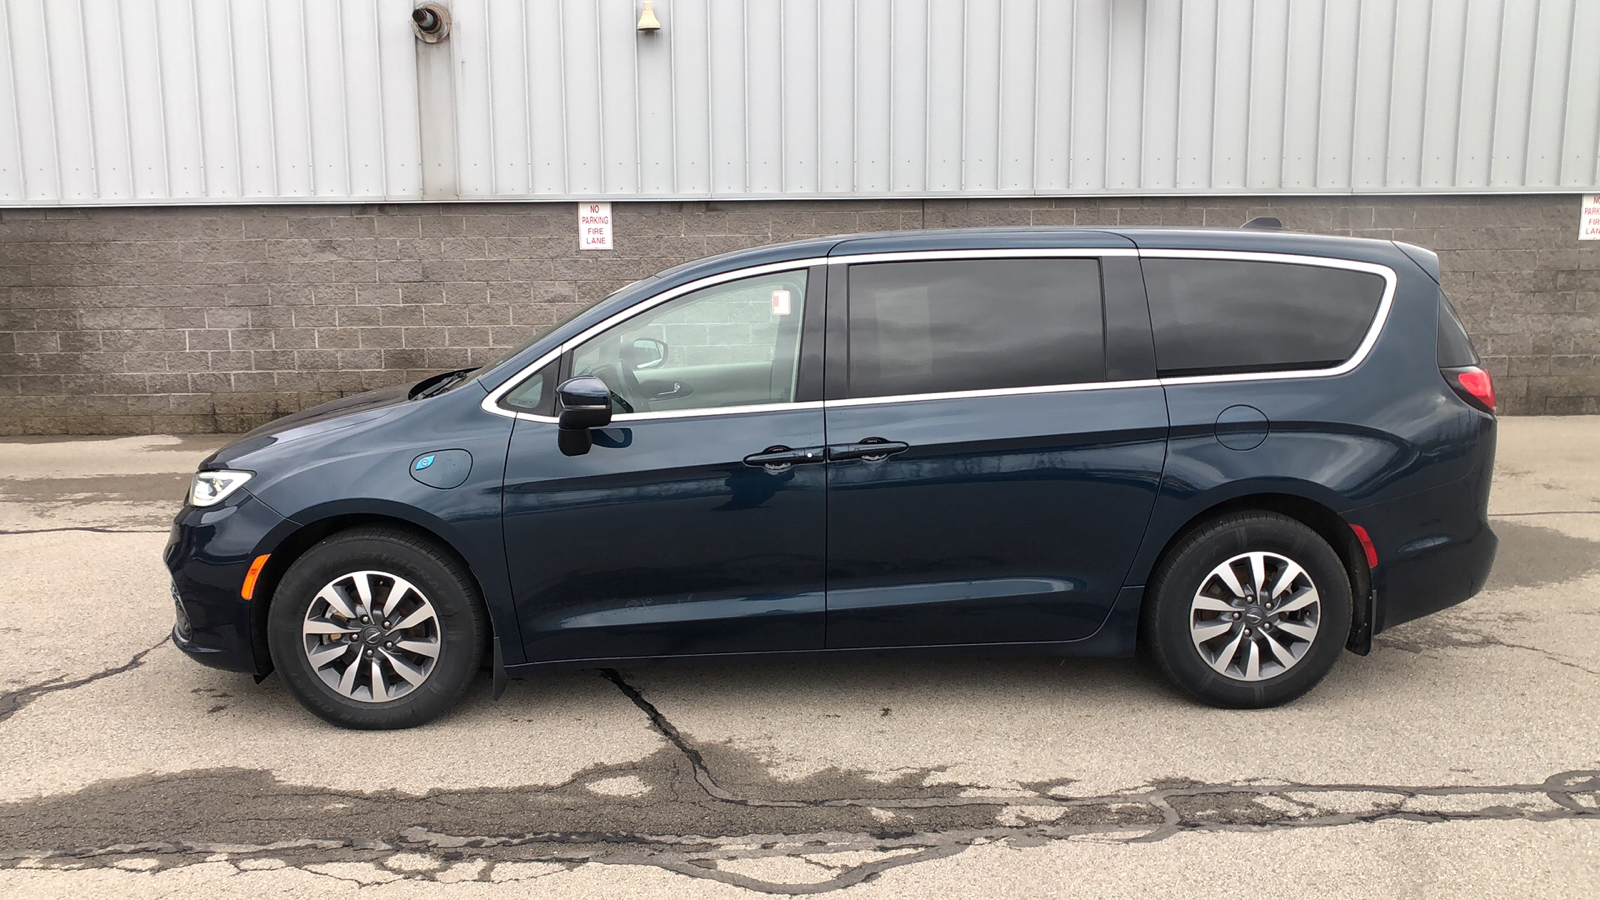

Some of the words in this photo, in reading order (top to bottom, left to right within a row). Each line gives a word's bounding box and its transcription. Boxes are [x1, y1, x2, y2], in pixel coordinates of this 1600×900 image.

[590, 204, 600, 214] NO
[581, 216, 609, 225] PARKING
[587, 227, 604, 235] FIRE
[586, 237, 606, 245] LANE
